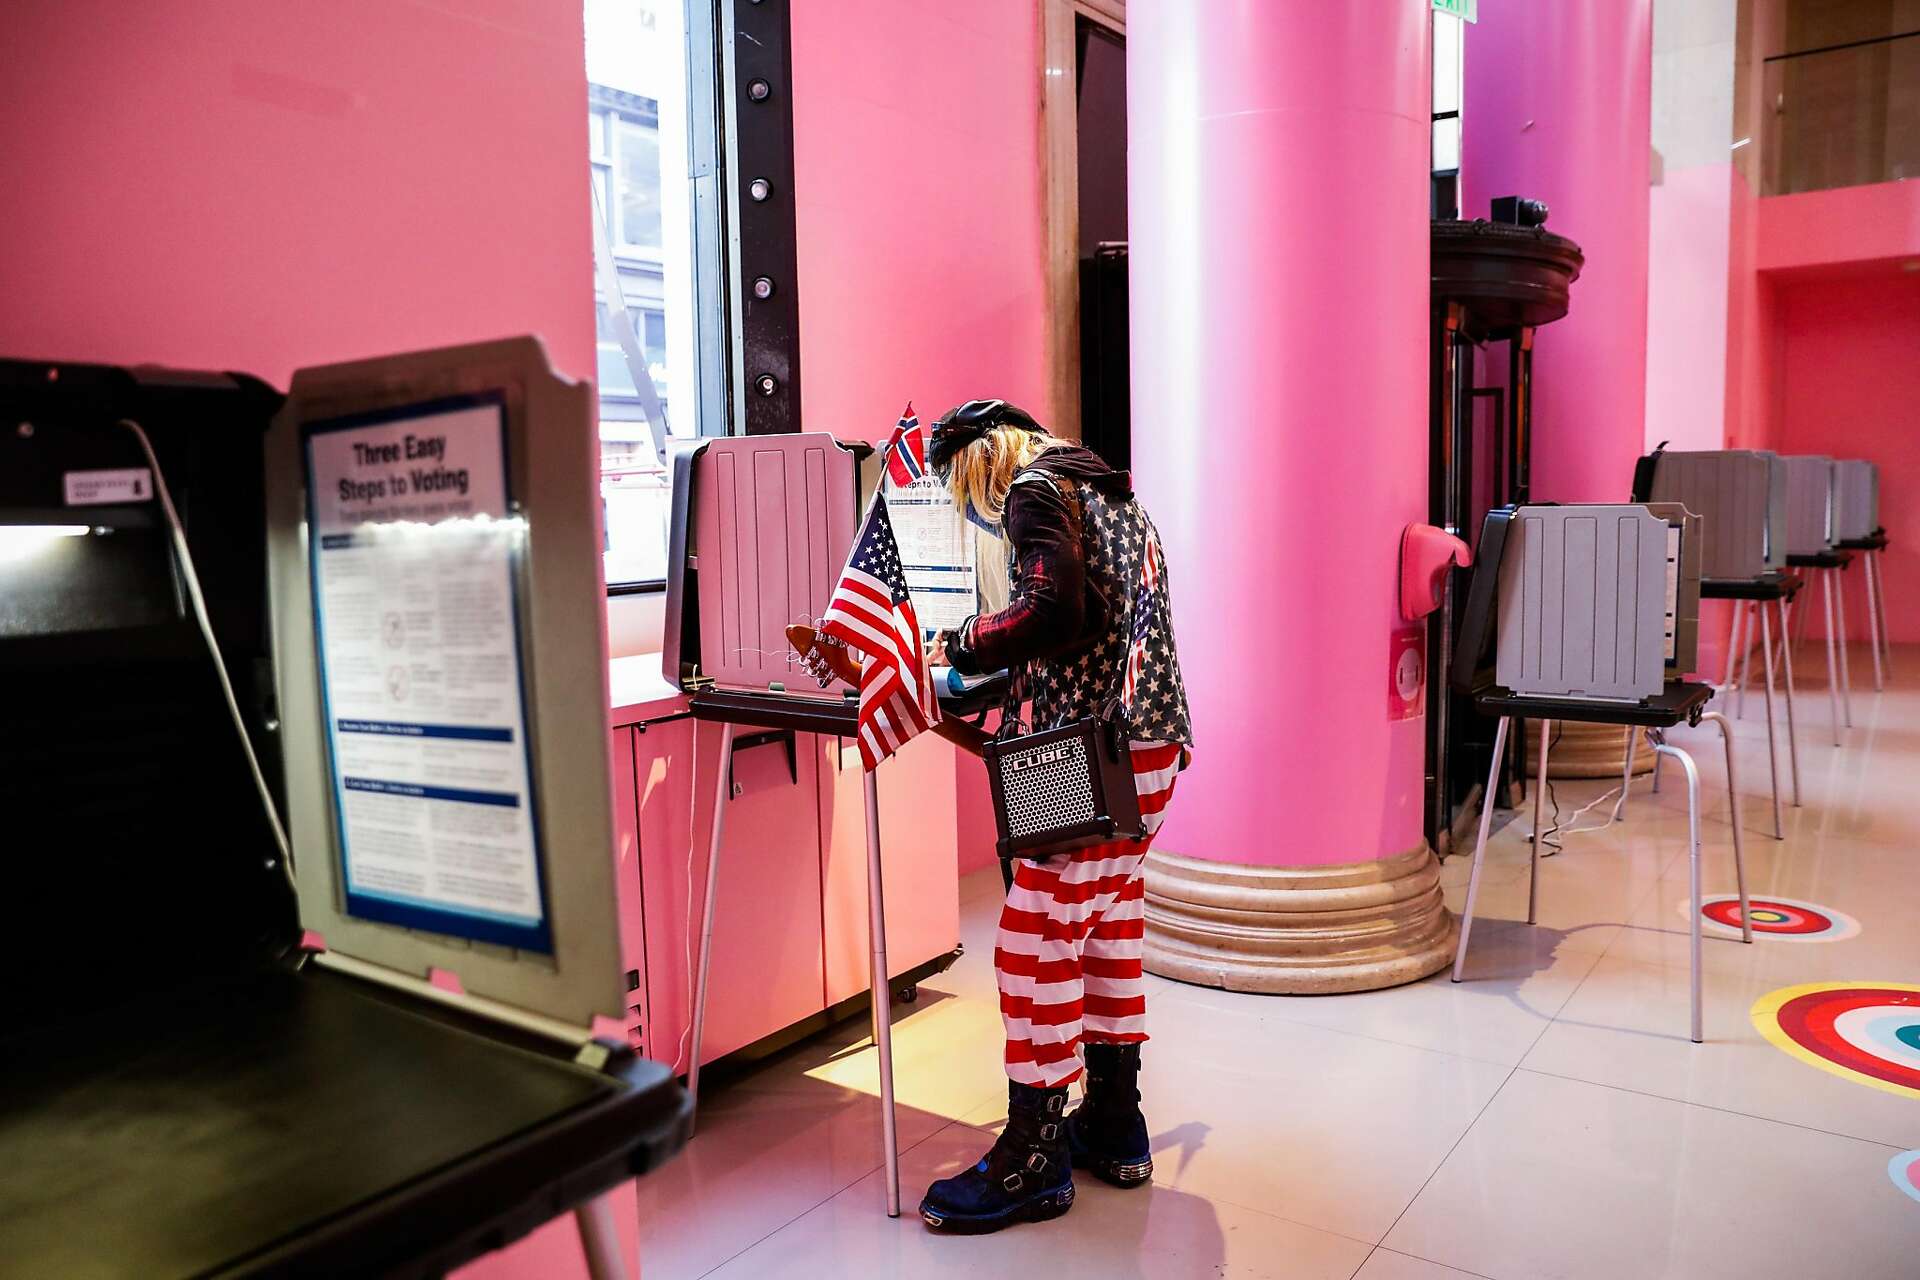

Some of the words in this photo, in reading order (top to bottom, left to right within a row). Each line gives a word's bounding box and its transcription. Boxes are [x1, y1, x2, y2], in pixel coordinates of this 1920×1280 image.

[352, 441, 400, 466] Three
[404, 434, 446, 462] Easy
[338, 476, 386, 504] Steps
[390, 474, 407, 495] to
[410, 466, 469, 495] Voting
[1013, 747, 1070, 770] CUBE
